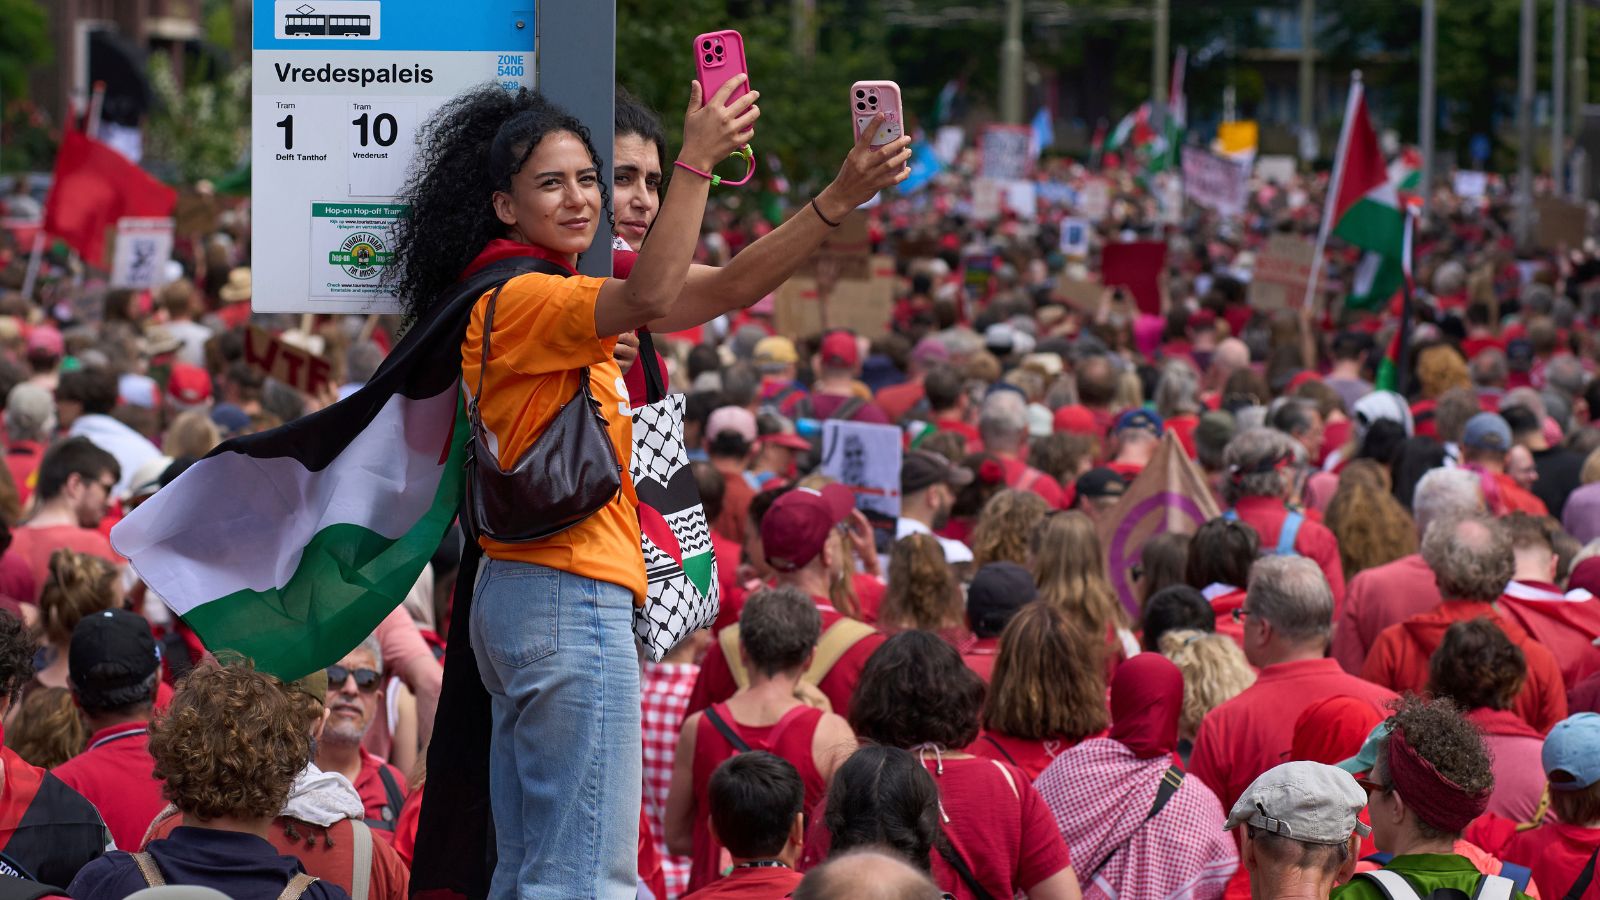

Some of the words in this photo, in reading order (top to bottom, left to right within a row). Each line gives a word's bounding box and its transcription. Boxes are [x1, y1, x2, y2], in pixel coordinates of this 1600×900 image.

[498, 55, 523, 65] ZONE
[274, 62, 434, 88] Vredespaleis
[498, 66, 524, 76] 5400
[276, 101, 296, 109] Tram
[276, 114, 293, 150] 1
[352, 112, 398, 147] 10
[276, 153, 295, 161] Delft
[297, 153, 327, 161] Tanthof
[325, 206, 352, 215] Hop-on
[354, 207, 382, 216] Hop-off
[343, 234, 366, 252] TOURIST
[366, 234, 383, 251] TRAM
[331, 254, 351, 262] hop-on
